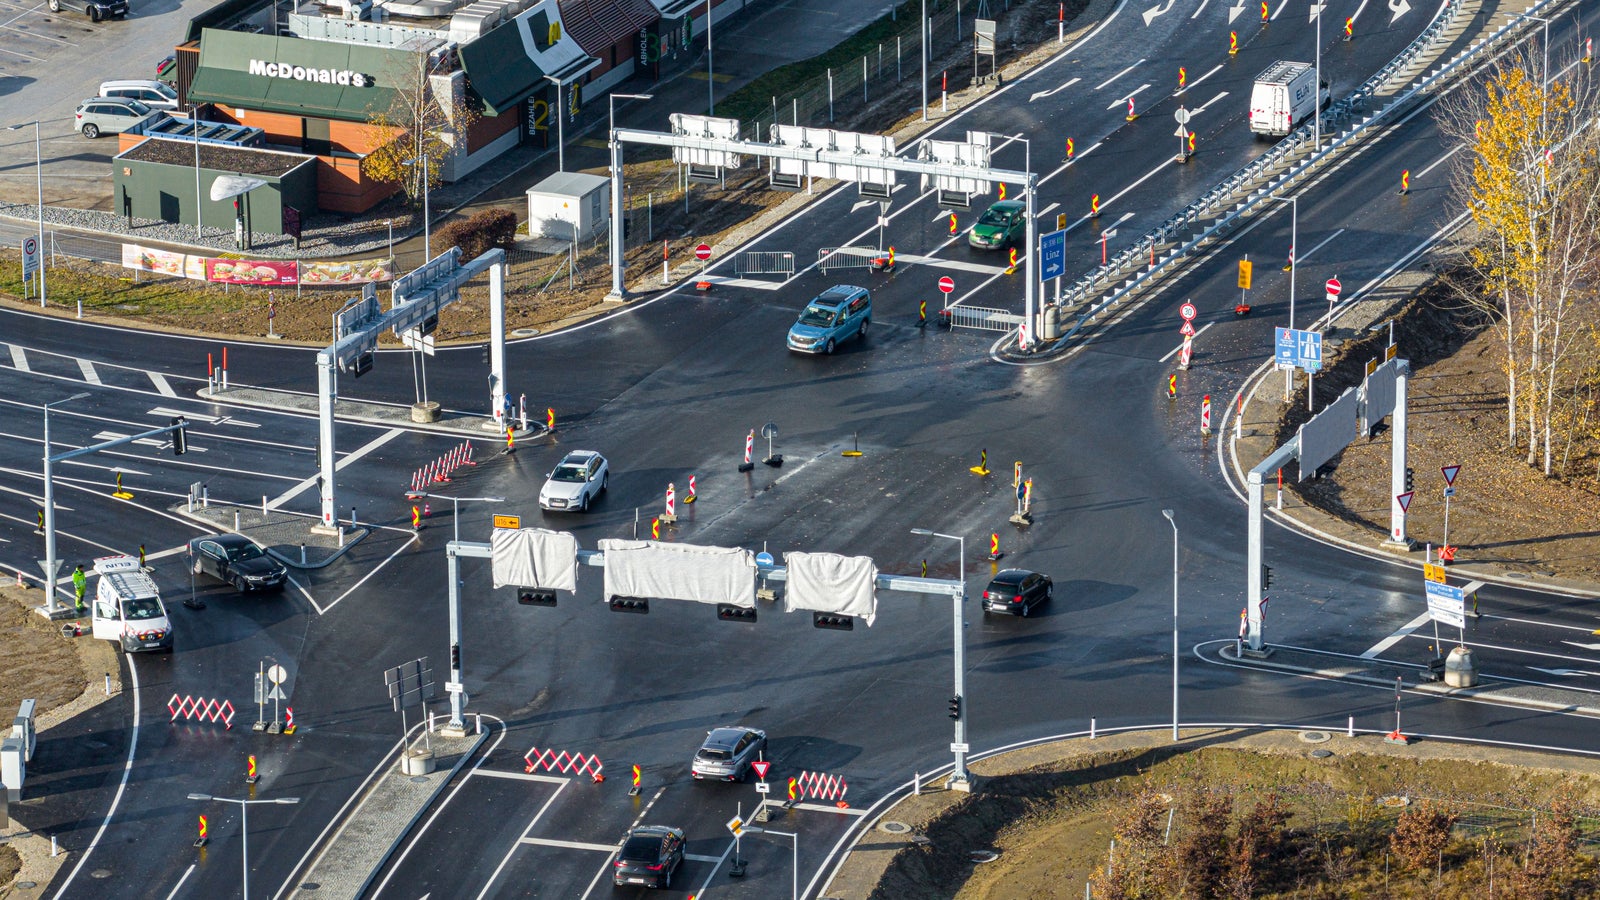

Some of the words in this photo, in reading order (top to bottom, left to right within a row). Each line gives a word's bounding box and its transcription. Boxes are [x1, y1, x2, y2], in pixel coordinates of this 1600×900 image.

[646, 32, 660, 62] 3
[249, 59, 364, 87] McDonald's
[534, 100, 548, 130] 2
[1046, 250, 1060, 260] Linz
[1184, 308, 1192, 316] 30
